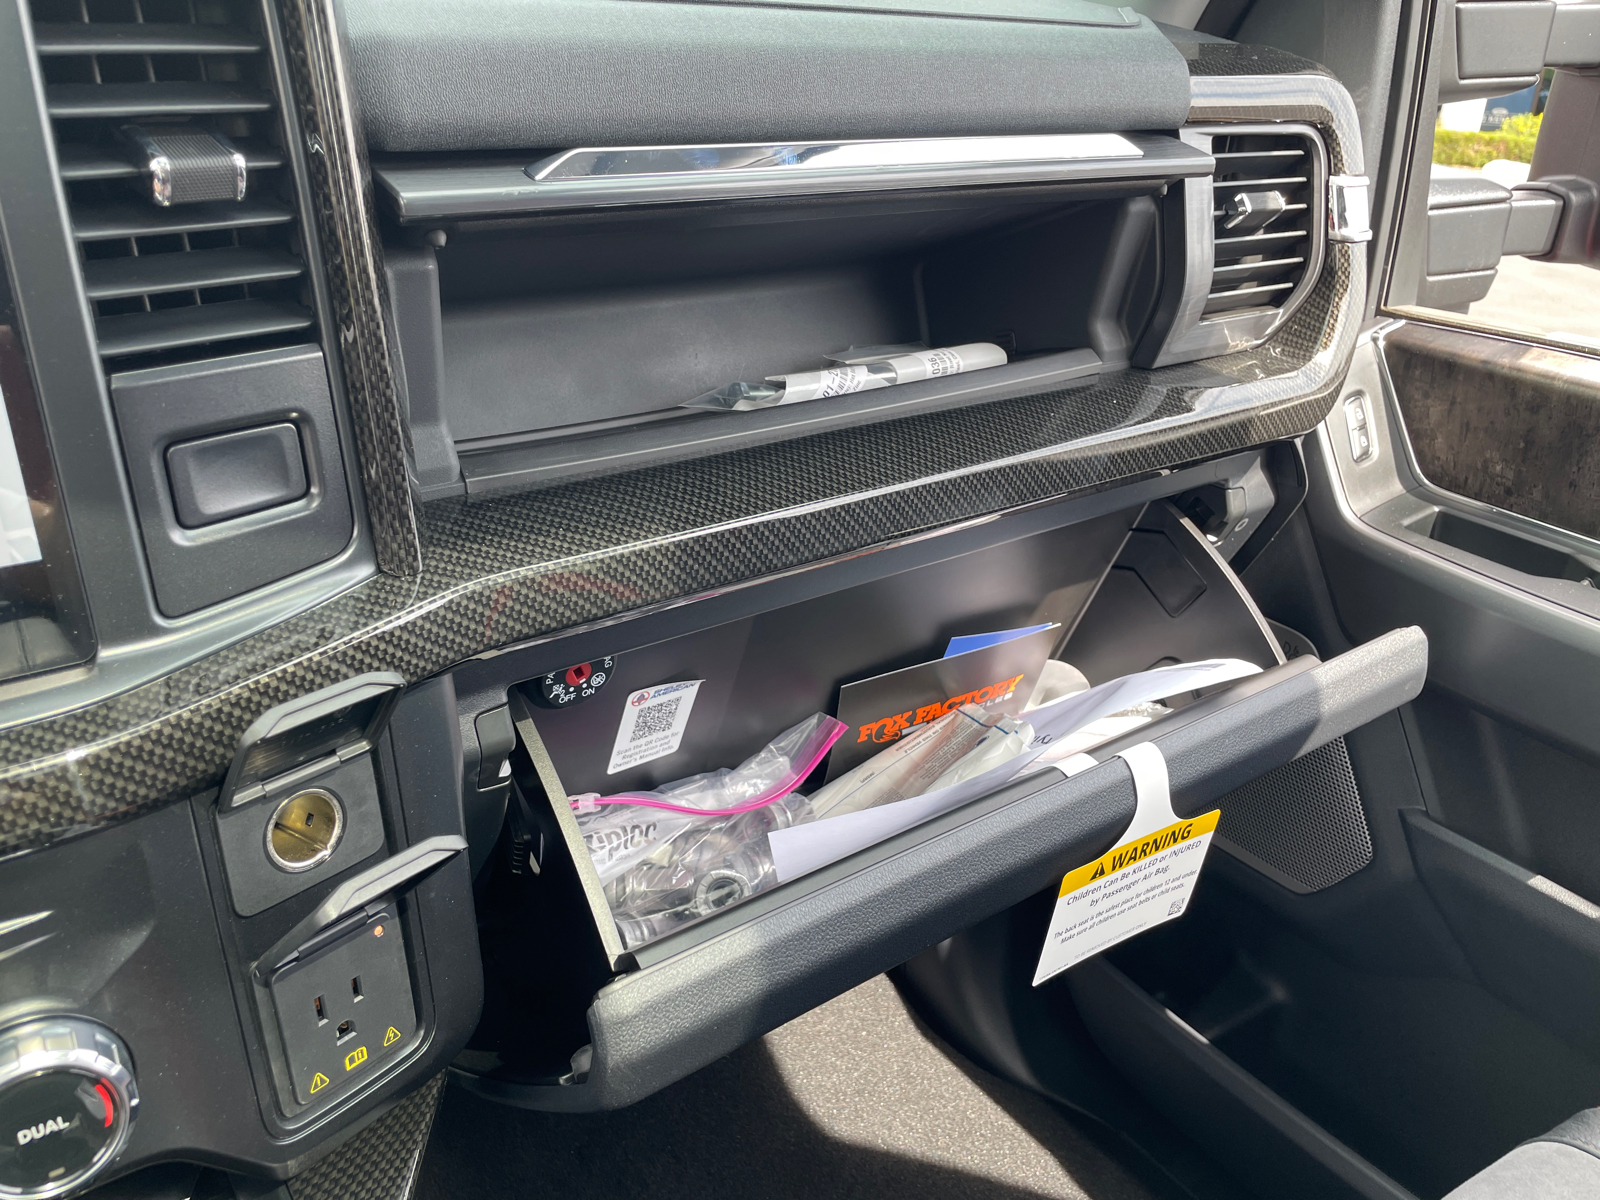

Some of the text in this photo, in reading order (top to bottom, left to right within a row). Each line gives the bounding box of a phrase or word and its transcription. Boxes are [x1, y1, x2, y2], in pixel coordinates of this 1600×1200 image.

[558, 687, 596, 704] OFF ON
[649, 682, 697, 700] AMERICAN
[857, 674, 1024, 743] FOX FACTORY
[613, 757, 638, 769] Owner's
[639, 748, 661, 760] Manual
[616, 747, 632, 756] Scan
[632, 743, 644, 751] the
[644, 739, 654, 747] QR
[654, 735, 670, 743] Code
[622, 739, 671, 760] Registration and
[1111, 823, 1194, 872] WARNING
[1067, 840, 1202, 906] Children Can Be KILLED or INJURED
[1089, 865, 1170, 908] by Passenger Air Bag.
[1054, 930, 1064, 940] The
[1064, 923, 1077, 934] back
[1077, 917, 1090, 928] seat
[1095, 910, 1104, 919] the
[1104, 902, 1120, 914] safest
[1120, 896, 1135, 908] place
[1134, 892, 1143, 900] for
[1143, 883, 1164, 896] children
[1170, 874, 1182, 884] and
[1181, 869, 1198, 880] under.
[1060, 932, 1076, 945] Make
[1076, 927, 1088, 937] sure
[1088, 921, 1096, 931] all
[1095, 913, 1117, 927] children
[1117, 907, 1127, 916] use
[1127, 902, 1138, 912] seat
[1138, 896, 1151, 906] belts
[1157, 886, 1171, 897] child
[1170, 882, 1185, 893] seats.
[17, 1116, 70, 1146] DUAL
